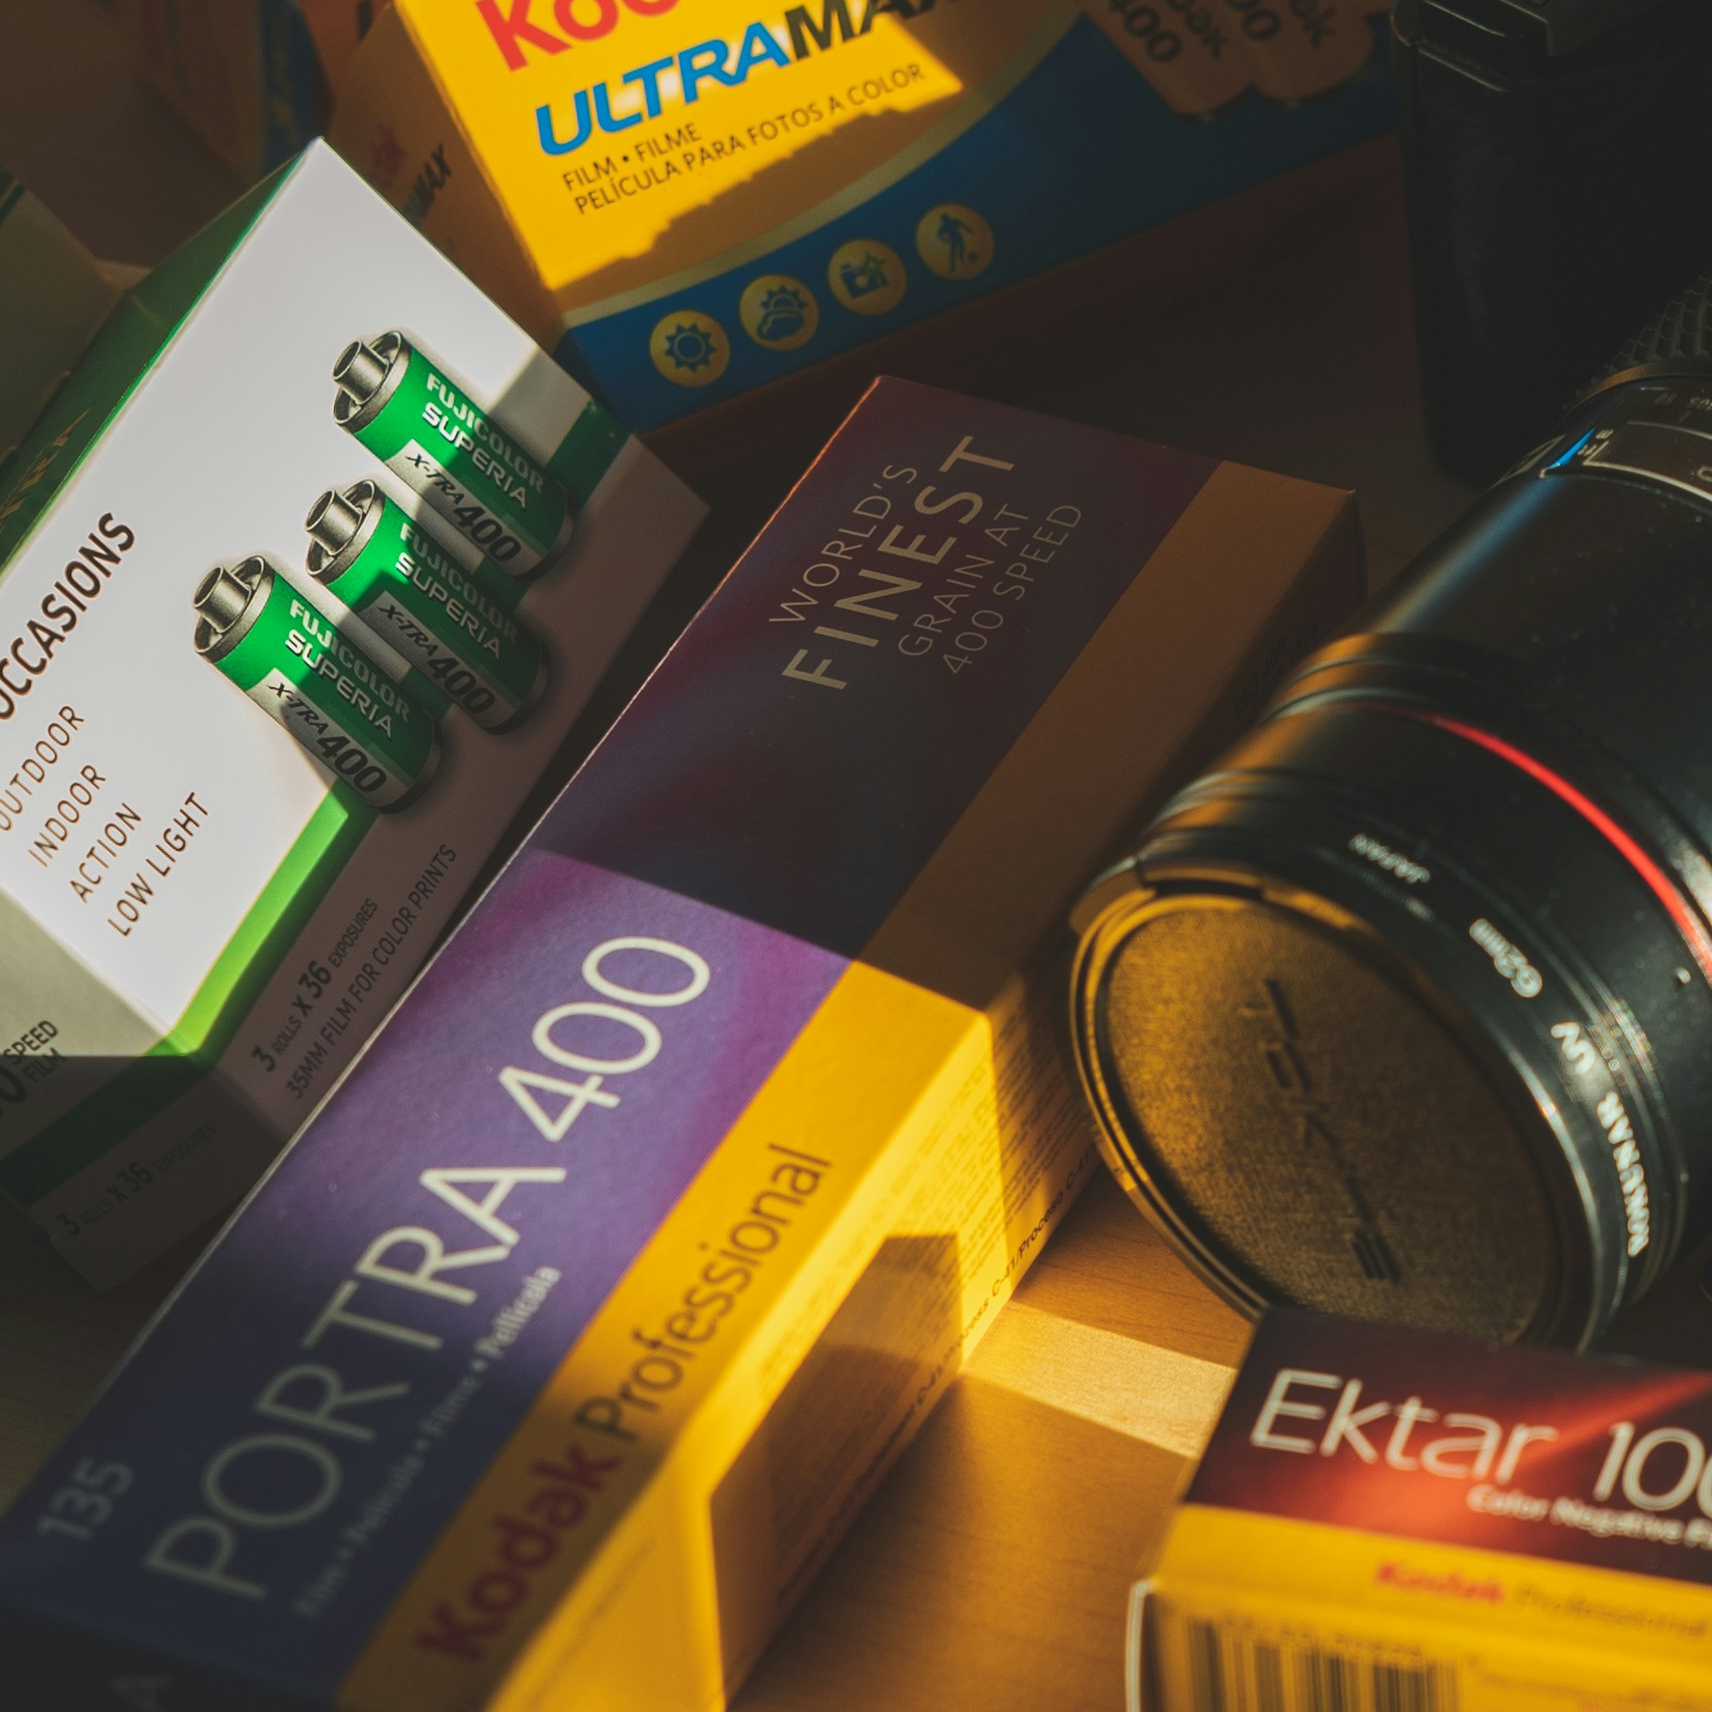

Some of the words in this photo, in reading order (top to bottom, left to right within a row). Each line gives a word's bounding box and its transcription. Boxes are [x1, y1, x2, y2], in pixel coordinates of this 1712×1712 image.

[562, 156, 618, 192] FILM
[635, 122, 703, 164] FILME
[574, 160, 682, 215] PELÍCULA
[682, 136, 744, 171] PARA
[748, 105, 823, 148] FOTOS
[829, 97, 846, 116] A
[847, 64, 924, 109] COLOR
[406, 452, 466, 506] X-TRA
[422, 402, 528, 510] SUPERIA
[427, 372, 546, 495] FUJICOLOR
[399, 520, 520, 645] FUJICOLOR
[453, 504, 521, 565] 400
[767, 463, 918, 624] WORLD'S
[780, 434, 1017, 691] FINEST
[897, 553, 996, 657] GRAIN
[983, 503, 1030, 548] AT
[941, 609, 1006, 676] 400
[991, 504, 1082, 601] SPEED
[0, 512, 136, 720] OCCASIONS
[289, 599, 410, 723] FUJICOLOR
[377, 601, 437, 656] X-TRA
[394, 551, 502, 662] SUPERIA
[267, 681, 328, 734] X-TRA
[285, 628, 394, 739] SUPERIA
[428, 651, 496, 717] 400
[0, 703, 86, 832] OUTDOOR
[27, 763, 108, 869] INDOOR
[317, 728, 388, 794] 400
[67, 800, 145, 905] ACTION
[106, 876, 155, 939] LOW
[157, 789, 212, 881] LIGHT
[250, 1043, 279, 1075] 3
[270, 1010, 304, 1053] ROLLS
[297, 960, 333, 1001] 36
[326, 897, 380, 970] EXPOSURES
[284, 1045, 327, 1100] 35MM
[323, 1002, 357, 1050] FILM
[348, 963, 383, 1007] FOR
[376, 905, 420, 968] COLOR
[408, 843, 458, 909] PRINTS
[4, 1018, 60, 1066] SPEED
[21, 1045, 66, 1084] FILM
[116, 1160, 155, 1197] 36
[143, 1165, 568, 1601] PORTRA
[498, 936, 711, 1143] 400
[415, 1440, 627, 1662] Kodak
[576, 1142, 834, 1446] Professional
[1251, 1367, 1559, 1486] Ektar
[36, 1455, 133, 1545] 135
